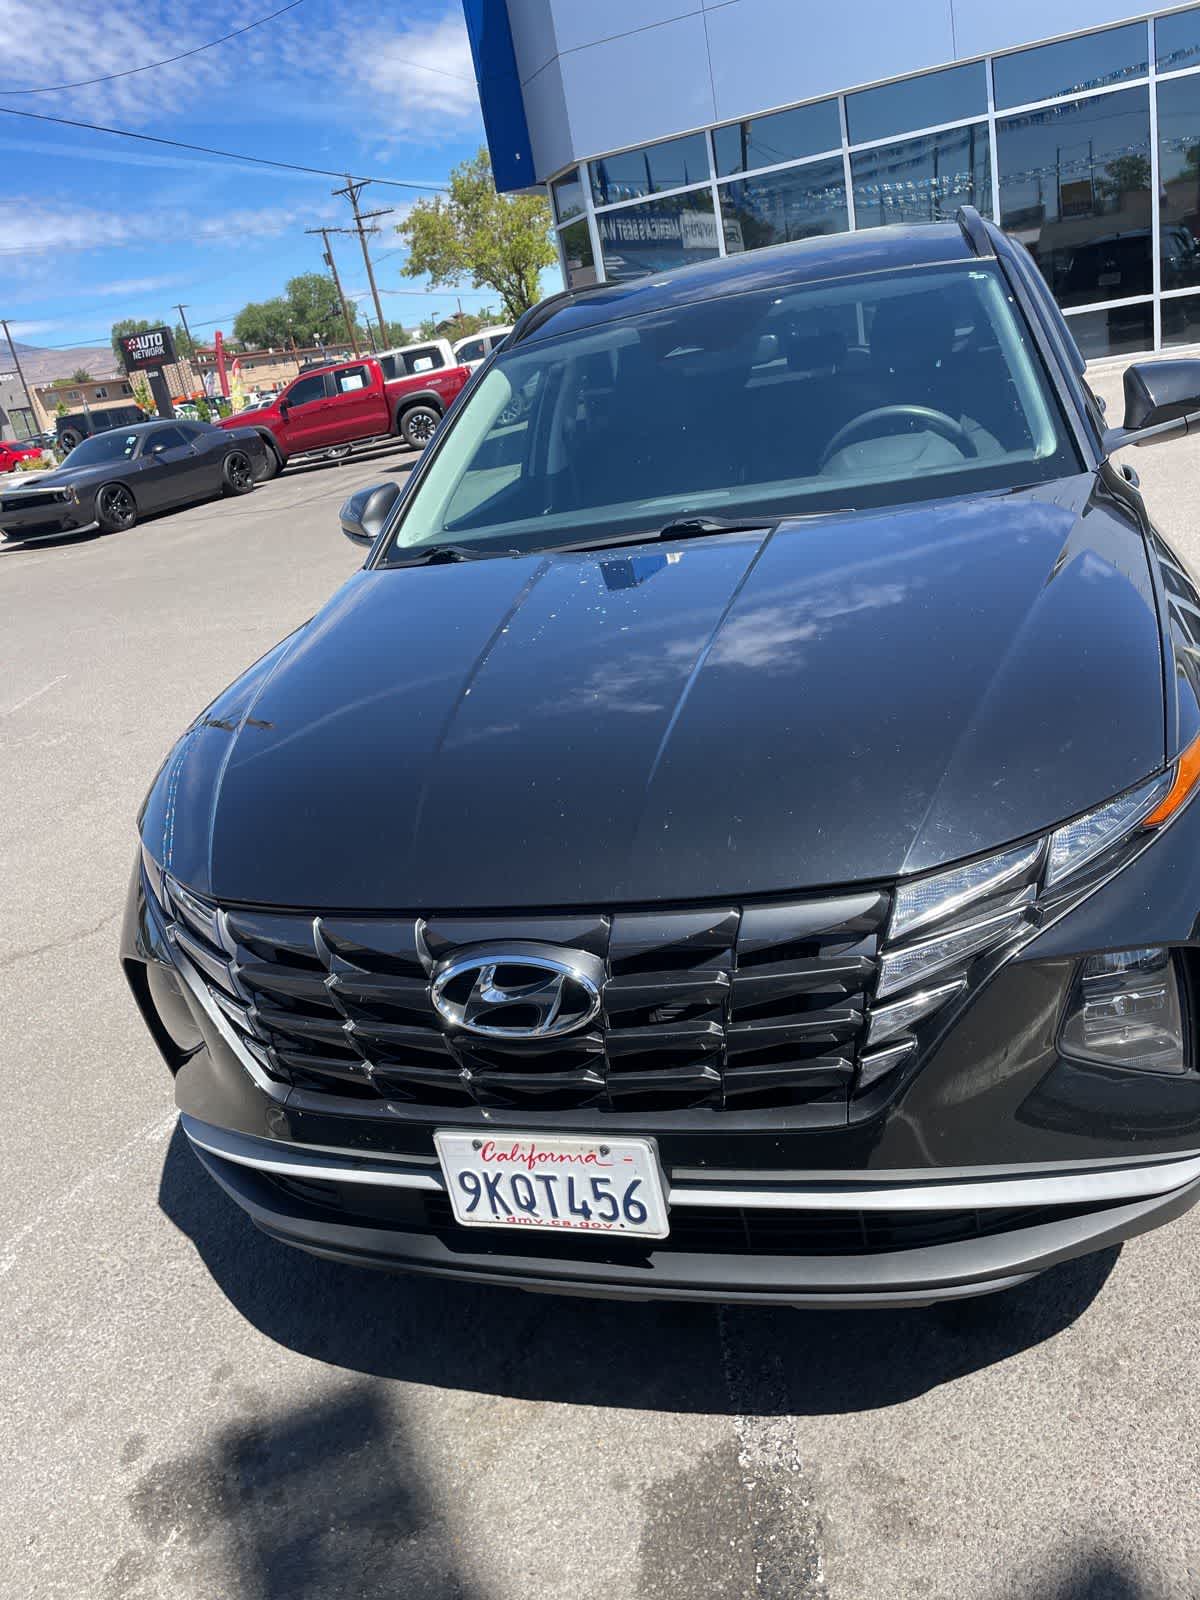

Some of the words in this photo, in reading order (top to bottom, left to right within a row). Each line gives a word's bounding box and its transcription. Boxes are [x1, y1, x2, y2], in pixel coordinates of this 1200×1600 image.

[135, 333, 163, 349] AUTO
[132, 345, 166, 360] NETWORK
[480, 1140, 613, 1170] California
[457, 1170, 648, 1226] 9KQT456
[506, 1215, 613, 1230] dmv.ca.gov
